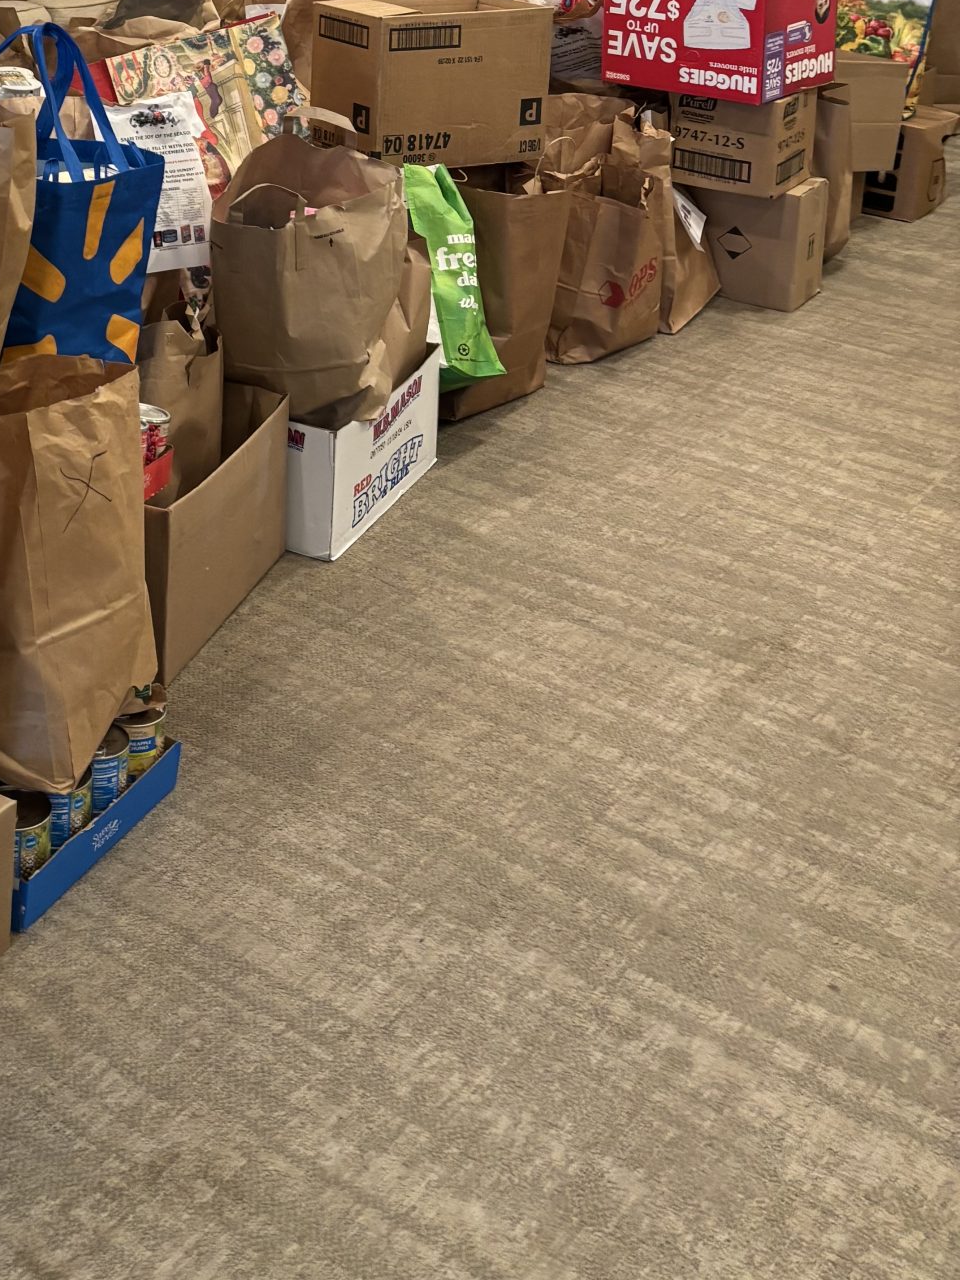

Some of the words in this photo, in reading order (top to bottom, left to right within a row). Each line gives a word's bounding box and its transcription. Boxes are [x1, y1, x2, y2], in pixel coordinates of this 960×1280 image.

[627, 20, 642, 30] TO
[644, 22, 659, 32] UP
[608, 29, 677, 63] SAVE
[739, 65, 757, 75] little
[785, 51, 833, 84] HUGGIES
[679, 67, 757, 94] HUGGIES
[765, 76, 781, 89] SAVE
[683, 95, 714, 110] Purell
[384, 137, 402, 155] 04
[407, 132, 450, 150] 47418
[675, 125, 744, 150] 9747-12-S
[403, 154, 426, 163] 36000
[391, 375, 423, 420] MASON
[352, 434, 423, 528] BRIGHT
[354, 474, 372, 497] RED
[390, 463, 410, 491] BLUE
